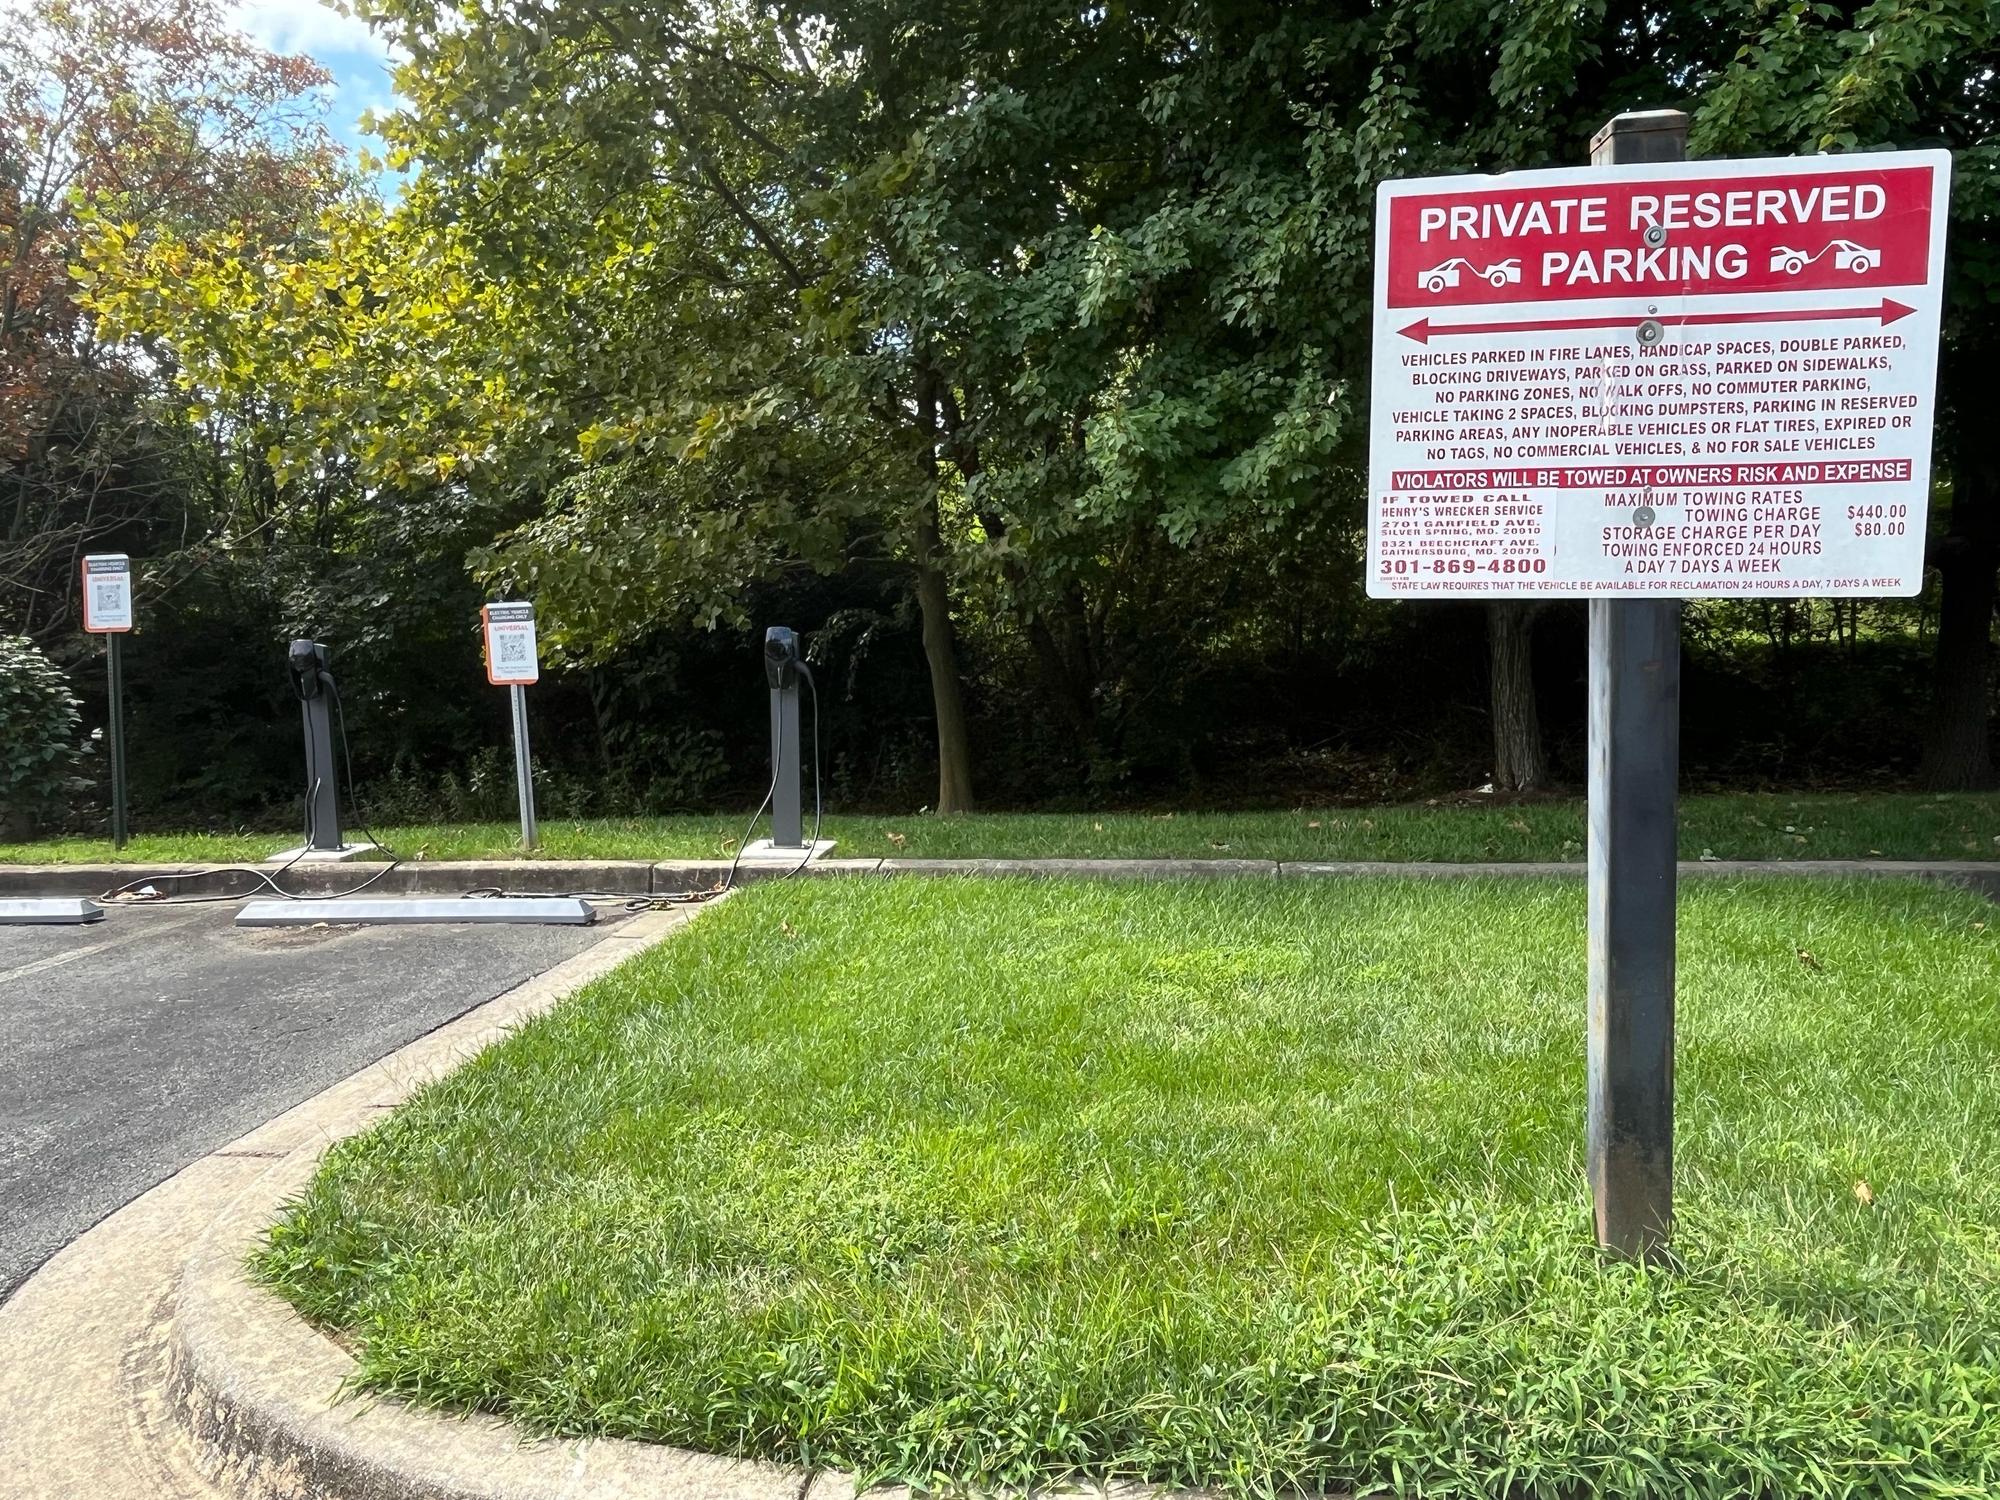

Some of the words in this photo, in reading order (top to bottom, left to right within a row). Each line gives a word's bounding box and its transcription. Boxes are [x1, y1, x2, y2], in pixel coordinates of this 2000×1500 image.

[1420, 198, 1607, 242] PRIVATE
[1631, 184, 1886, 230] RESERVED
[1542, 244, 1748, 287] PARKING
[1402, 353, 1466, 366] VEHICLES
[1472, 351, 1525, 363] PARKED
[1531, 350, 1544, 361] IN
[1550, 348, 1580, 360] FIRE
[1586, 346, 1634, 360] LANES,
[1639, 343, 1712, 357] HANDICAP
[1717, 341, 1774, 355] SPACES,
[1781, 339, 1838, 352] DOUBLE
[1844, 336, 1905, 350] PARKED,
[1413, 372, 1481, 385] BLOCKING
[1487, 368, 1569, 382] DRIVEWAYS,
[1575, 366, 1630, 379] PARKED
[1635, 365, 1654, 377] ON
[1660, 363, 1710, 377] GRASS,
[1717, 361, 1772, 374] PARKED
[1778, 360, 1797, 372] ON
[1803, 356, 1891, 371] SIDEWALKS,
[1436, 392, 1454, 403] NO
[1460, 389, 1519, 402] PARKING
[1524, 387, 1573, 401] ZONES,
[1580, 387, 1598, 398] NO
[1648, 384, 1686, 398] OFFS,
[1692, 383, 1711, 395] NO
[1717, 381, 1797, 394] COMMUTER
[1803, 378, 1870, 392] PARKING,
[1393, 411, 1448, 423] VEHICLE
[1454, 409, 1503, 421] TAKING
[1509, 408, 1515, 419] 2
[1521, 406, 1576, 419] SPACES,
[1582, 404, 1654, 418] BLOCKING
[1659, 402, 1748, 416] DUMPSTERS,
[1754, 400, 1815, 413] PARKING
[1822, 399, 1835, 411] IN
[1841, 396, 1917, 410] RESERVED
[1397, 429, 1454, 442] PARKING
[1459, 428, 1507, 441] AREAS,
[1512, 427, 1540, 438] ANY
[1546, 424, 1632, 437] INOPERABLE
[1638, 422, 1706, 435] VEHICLES
[1712, 422, 1730, 433] OR
[1736, 421, 1769, 433] FLAT
[1774, 419, 1818, 433] TIRES,
[1825, 417, 1886, 430] EXPIRED
[1892, 416, 1911, 428] OR
[1428, 449, 1445, 459] NO
[1450, 447, 1488, 459] TAGS,
[1494, 447, 1512, 458] NO
[1518, 444, 1609, 457] COMMERCIAL
[1615, 442, 1685, 456] VEHICLES,
[1692, 442, 1700, 454] &
[1707, 442, 1726, 453] NO
[1732, 441, 1758, 452] FOR
[1765, 440, 1799, 452] SALE
[1805, 437, 1875, 450] VEHICLES
[1397, 473, 1487, 488] VIOLATORS
[1493, 472, 1532, 486] WILL
[1537, 471, 1559, 485] BE
[1565, 470, 1626, 485] TOWED
[1630, 469, 1651, 484] AT
[1656, 468, 1732, 483] OWNERS
[1738, 467, 1778, 482] RISK
[1782, 466, 1819, 481] AND
[1825, 463, 1907, 480] EXPENSE
[1408, 495, 1473, 503] TOWED
[1484, 494, 1531, 502] CALL
[1605, 492, 1677, 507] MAXIMUM
[1683, 492, 1745, 505] TOWING
[1752, 491, 1802, 504] RATES
[1382, 507, 1429, 517] HENRY'S
[1435, 506, 1489, 516] WRECKER
[1495, 505, 1542, 515] SERVICE
[1685, 508, 1747, 522] TOWING
[1754, 507, 1820, 521] CHARGE
[1848, 505, 1906, 519] $440.00
[1602, 525, 1675, 540] STORAGE
[1682, 526, 1747, 539] CHARGE
[1754, 525, 1784, 538] PER
[1791, 524, 1821, 537] DAY
[1855, 522, 1904, 536] $80.00
[1603, 543, 1657, 557] TOWING
[1664, 543, 1743, 556] ENFORCED
[1749, 542, 1764, 555] 24
[1770, 541, 1821, 555] HOURS
[1381, 559, 1545, 574] 301-869-4800
[1625, 560, 1633, 573] A
[1638, 560, 1665, 573] DAY
[1670, 560, 1676, 573] 7
[1682, 560, 1719, 573] DAYS
[1724, 560, 1733, 573] A
[1738, 559, 1780, 572] WEEK
[1392, 582, 1419, 590] STATE
[1421, 582, 1440, 590] LAW
[1442, 582, 1488, 590] REQUIRES
[1491, 582, 1515, 590] THAT
[1538, 582, 1577, 590] VEHICLE
[1580, 582, 1592, 590] BE
[1595, 581, 1645, 589] AVAILABLE
[1649, 581, 1667, 589] FOR
[1670, 581, 1739, 589] RECLAMATION
[1742, 581, 1752, 589] 24
[1756, 580, 1790, 589] HOURS
[1793, 580, 1799, 588] A
[1802, 580, 1822, 589] DAY,
[1834, 579, 1859, 587] DAYS
[1862, 579, 1869, 587] A
[1872, 579, 1900, 587] WEEK
